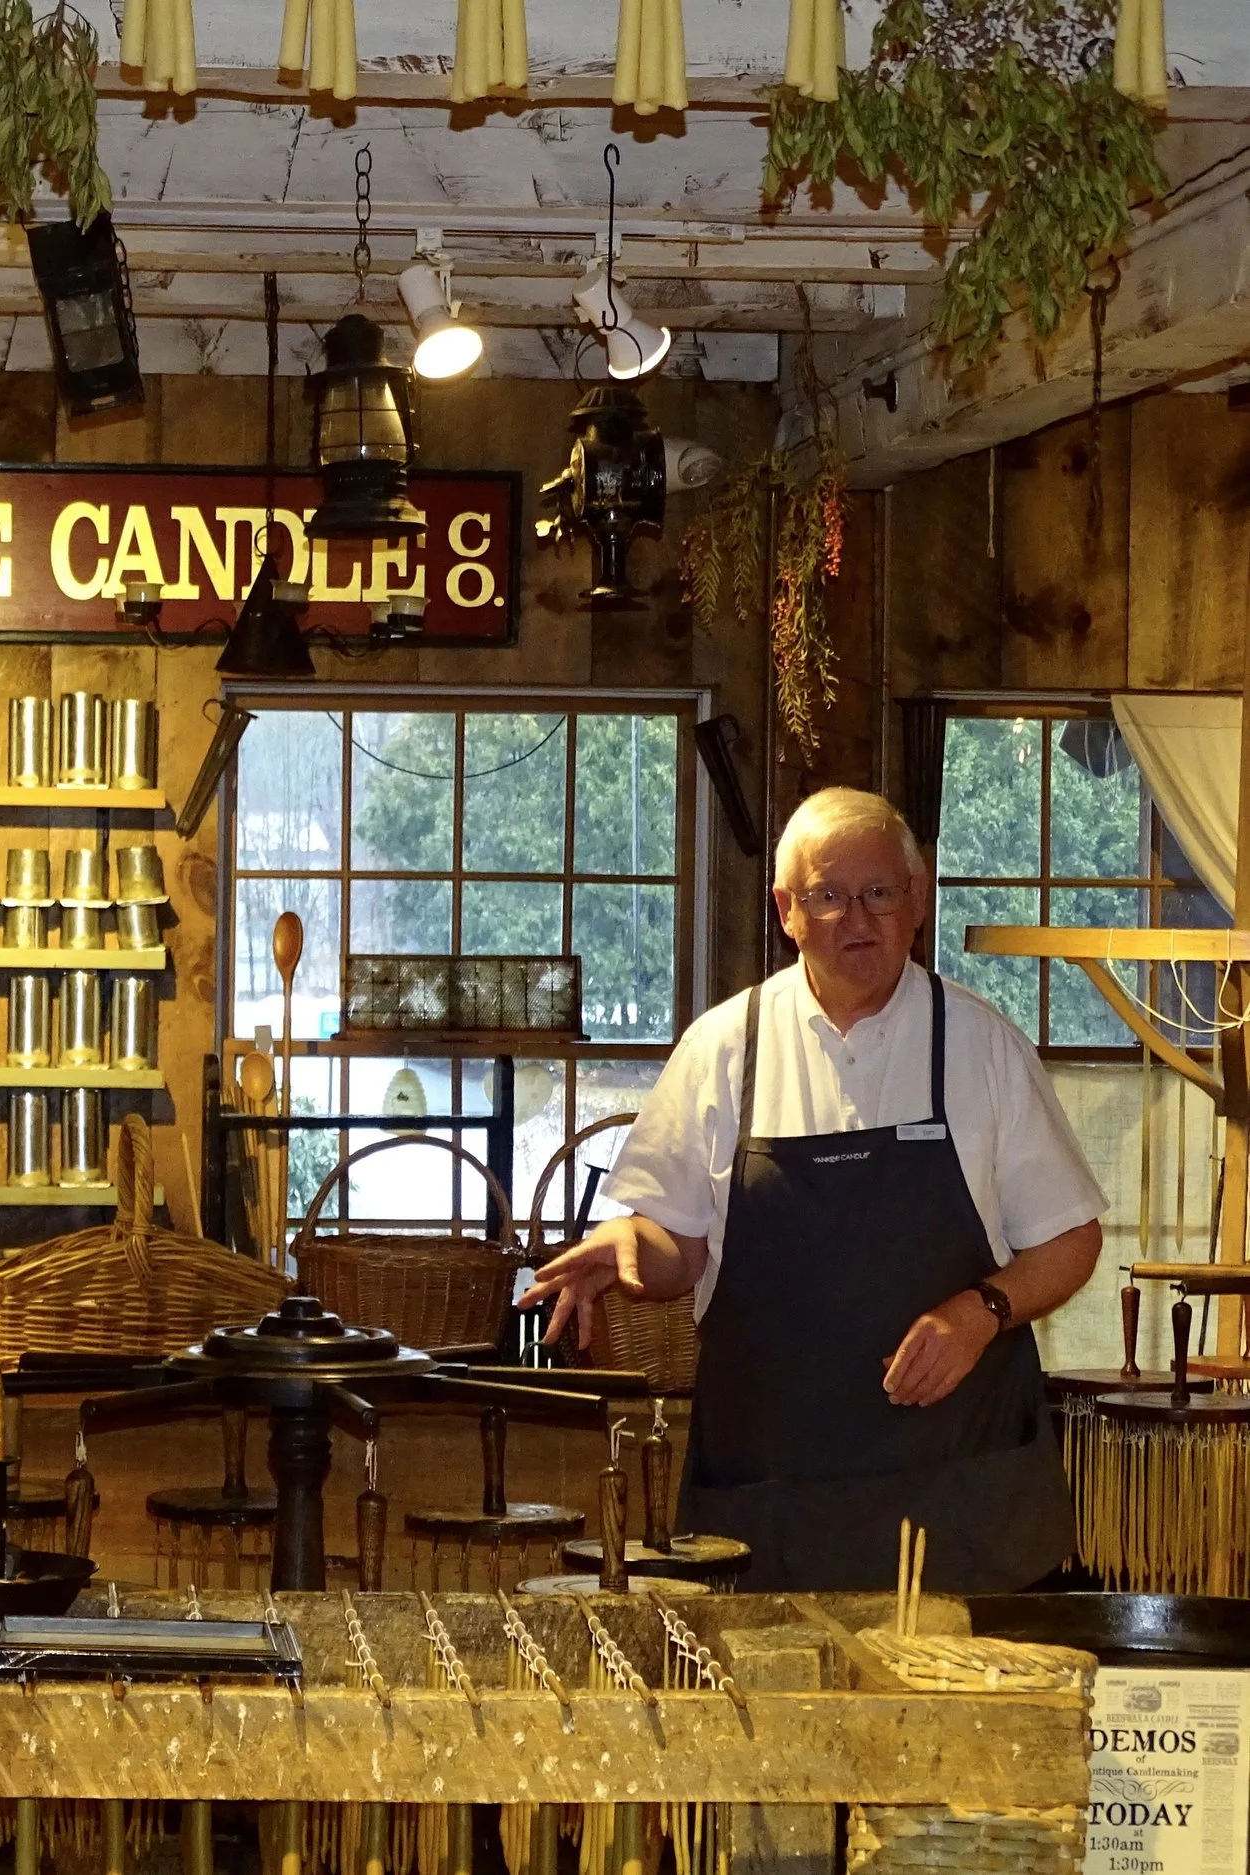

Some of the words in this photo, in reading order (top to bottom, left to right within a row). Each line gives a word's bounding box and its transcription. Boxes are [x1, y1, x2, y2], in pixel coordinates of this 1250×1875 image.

[50, 501, 426, 602] CANDLE
[1089, 1729, 1197, 1753] DEMOS
[1135, 1755, 1146, 1764] of
[1093, 1767, 1123, 1777] ntique
[1126, 1767, 1199, 1778] Candlemaking
[1089, 1802, 1193, 1826] TODAY
[1134, 1829, 1143, 1837] at
[1090, 1837, 1143, 1851] 1:30am
[1109, 1857, 1164, 1874] 1:30pm
